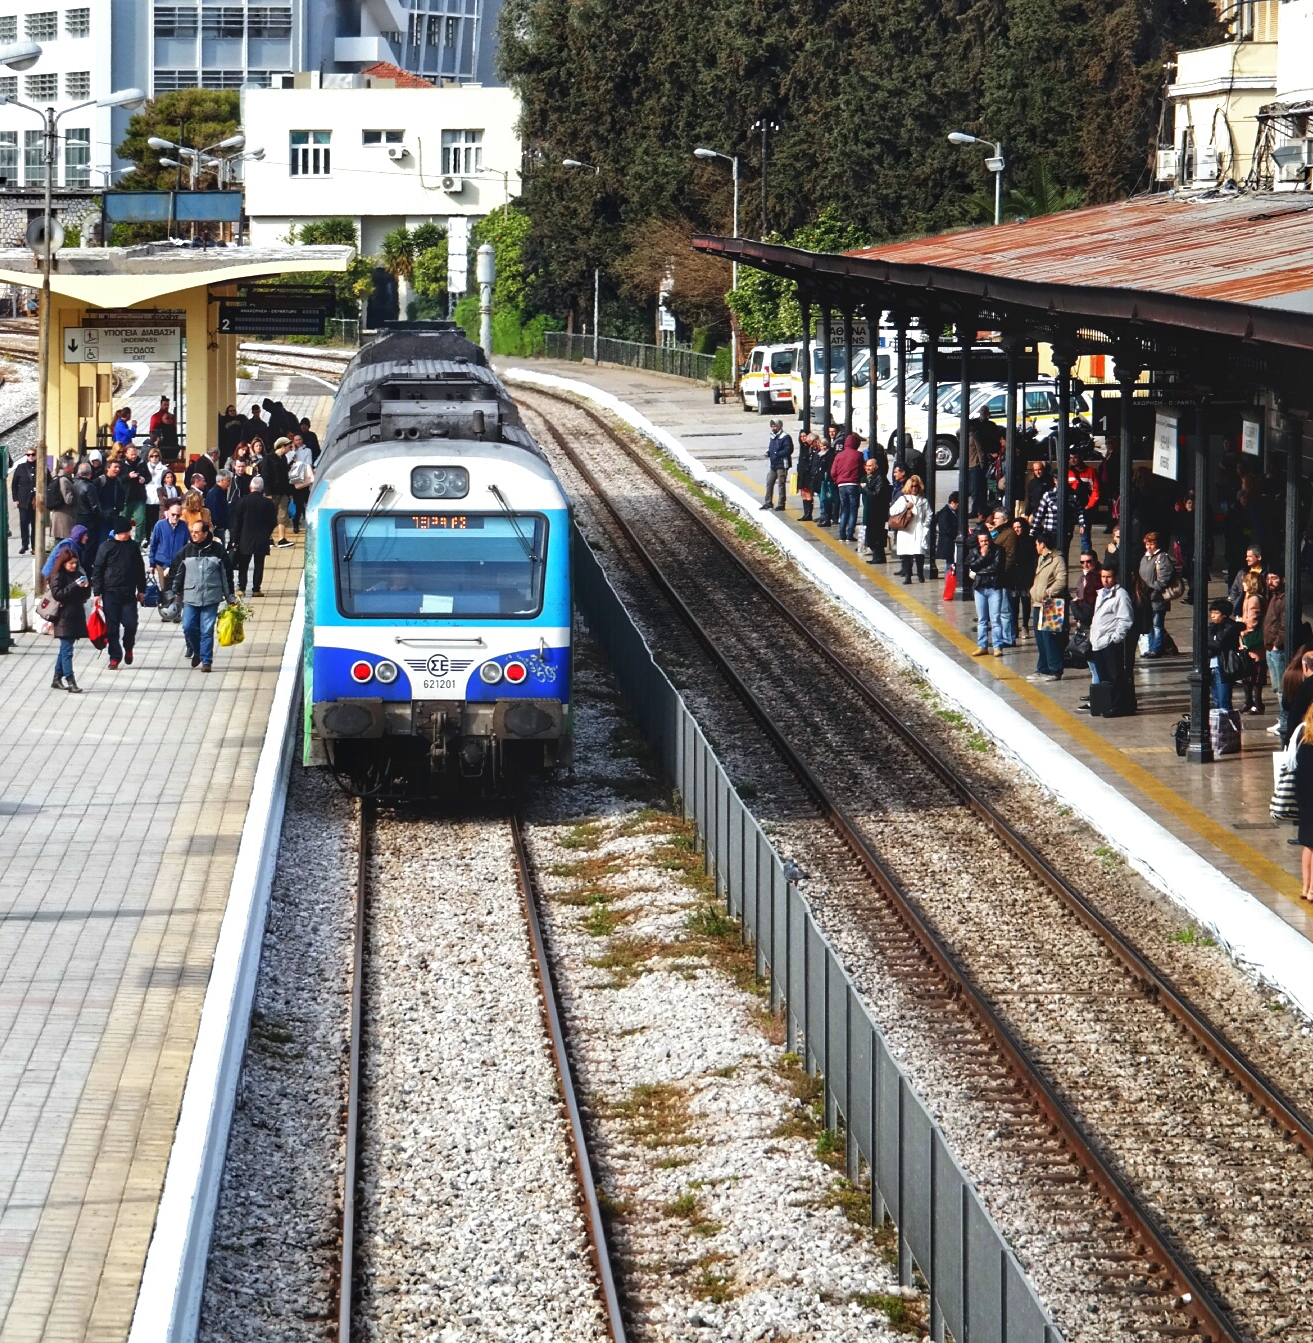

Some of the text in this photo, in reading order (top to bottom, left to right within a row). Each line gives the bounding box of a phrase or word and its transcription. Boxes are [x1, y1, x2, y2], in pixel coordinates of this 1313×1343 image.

[222, 319, 230, 330] 2
[141, 328, 176, 336] ΔΙΑΒΑΣΗ
[830, 326, 867, 336] ΑΘΝΑ
[831, 336, 865, 344] ATHNS
[123, 346, 156, 354] ΕΞΟΔΟΣ
[1098, 416, 1107, 431] 1
[423, 679, 455, 689] 621201
